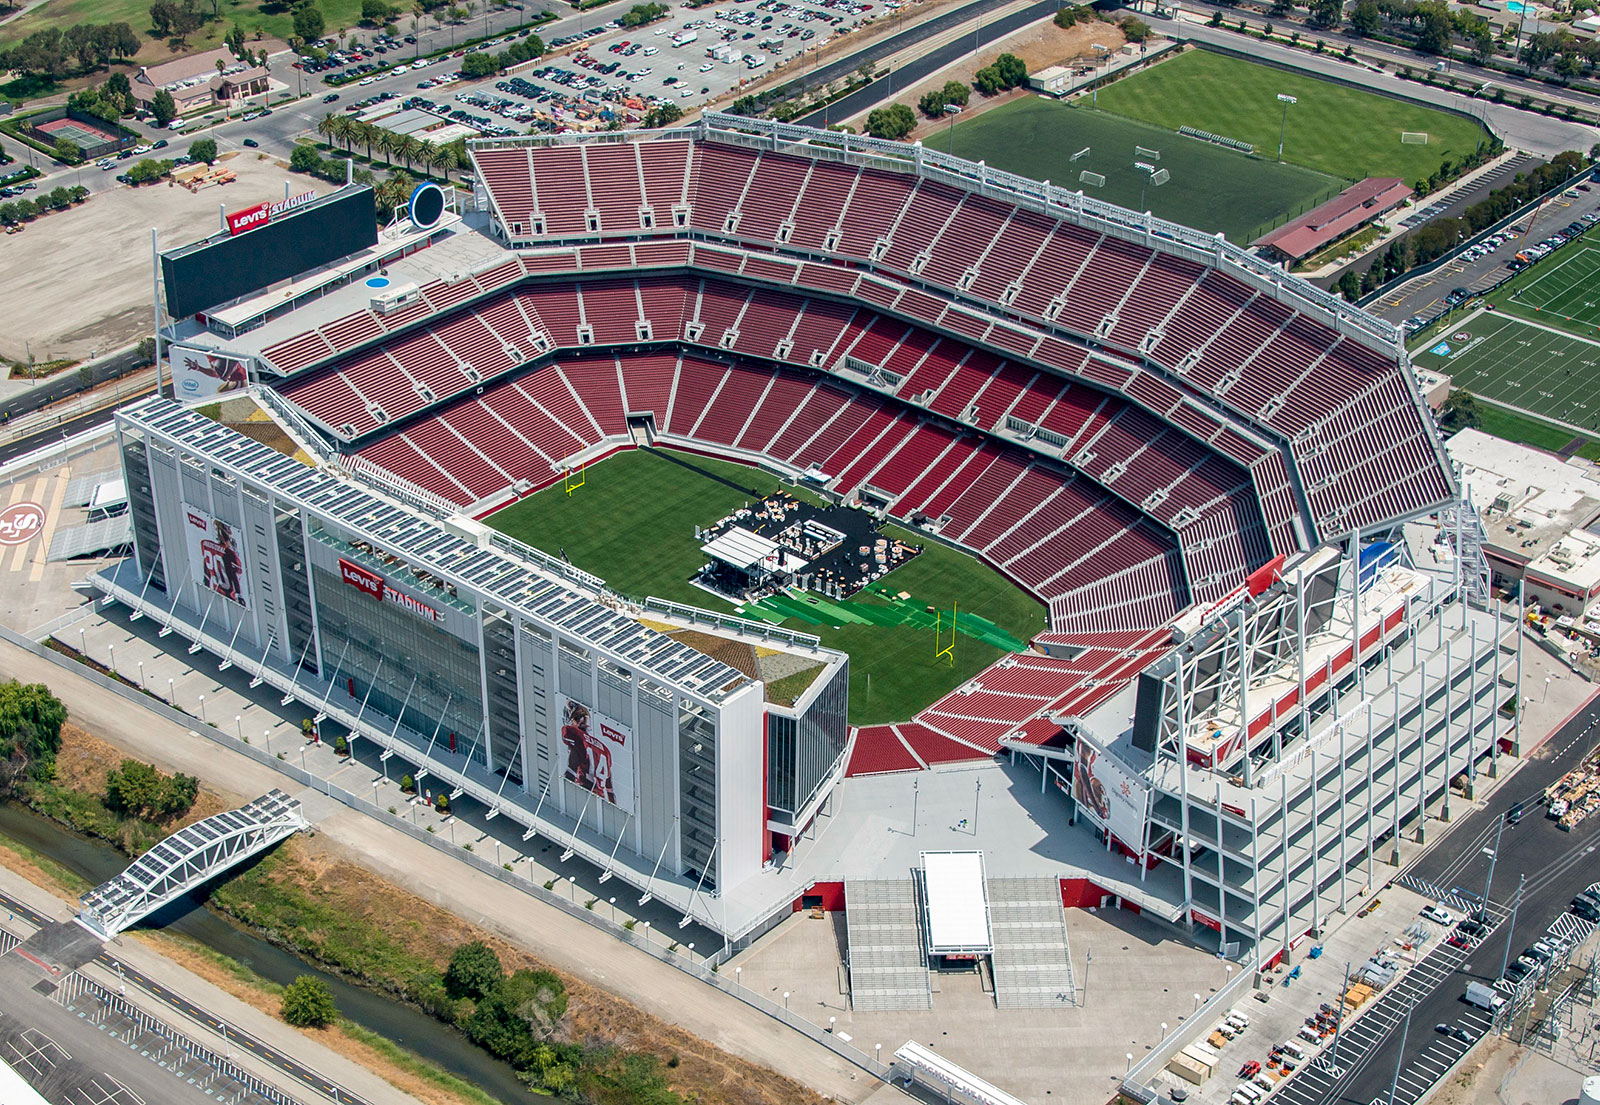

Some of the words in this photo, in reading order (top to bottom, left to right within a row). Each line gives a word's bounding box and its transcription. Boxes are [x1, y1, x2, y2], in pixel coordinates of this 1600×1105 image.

[270, 190, 317, 215] STADIUM
[203, 550, 231, 591] 20
[383, 585, 437, 621] STADIUM
[585, 746, 610, 788] 14
